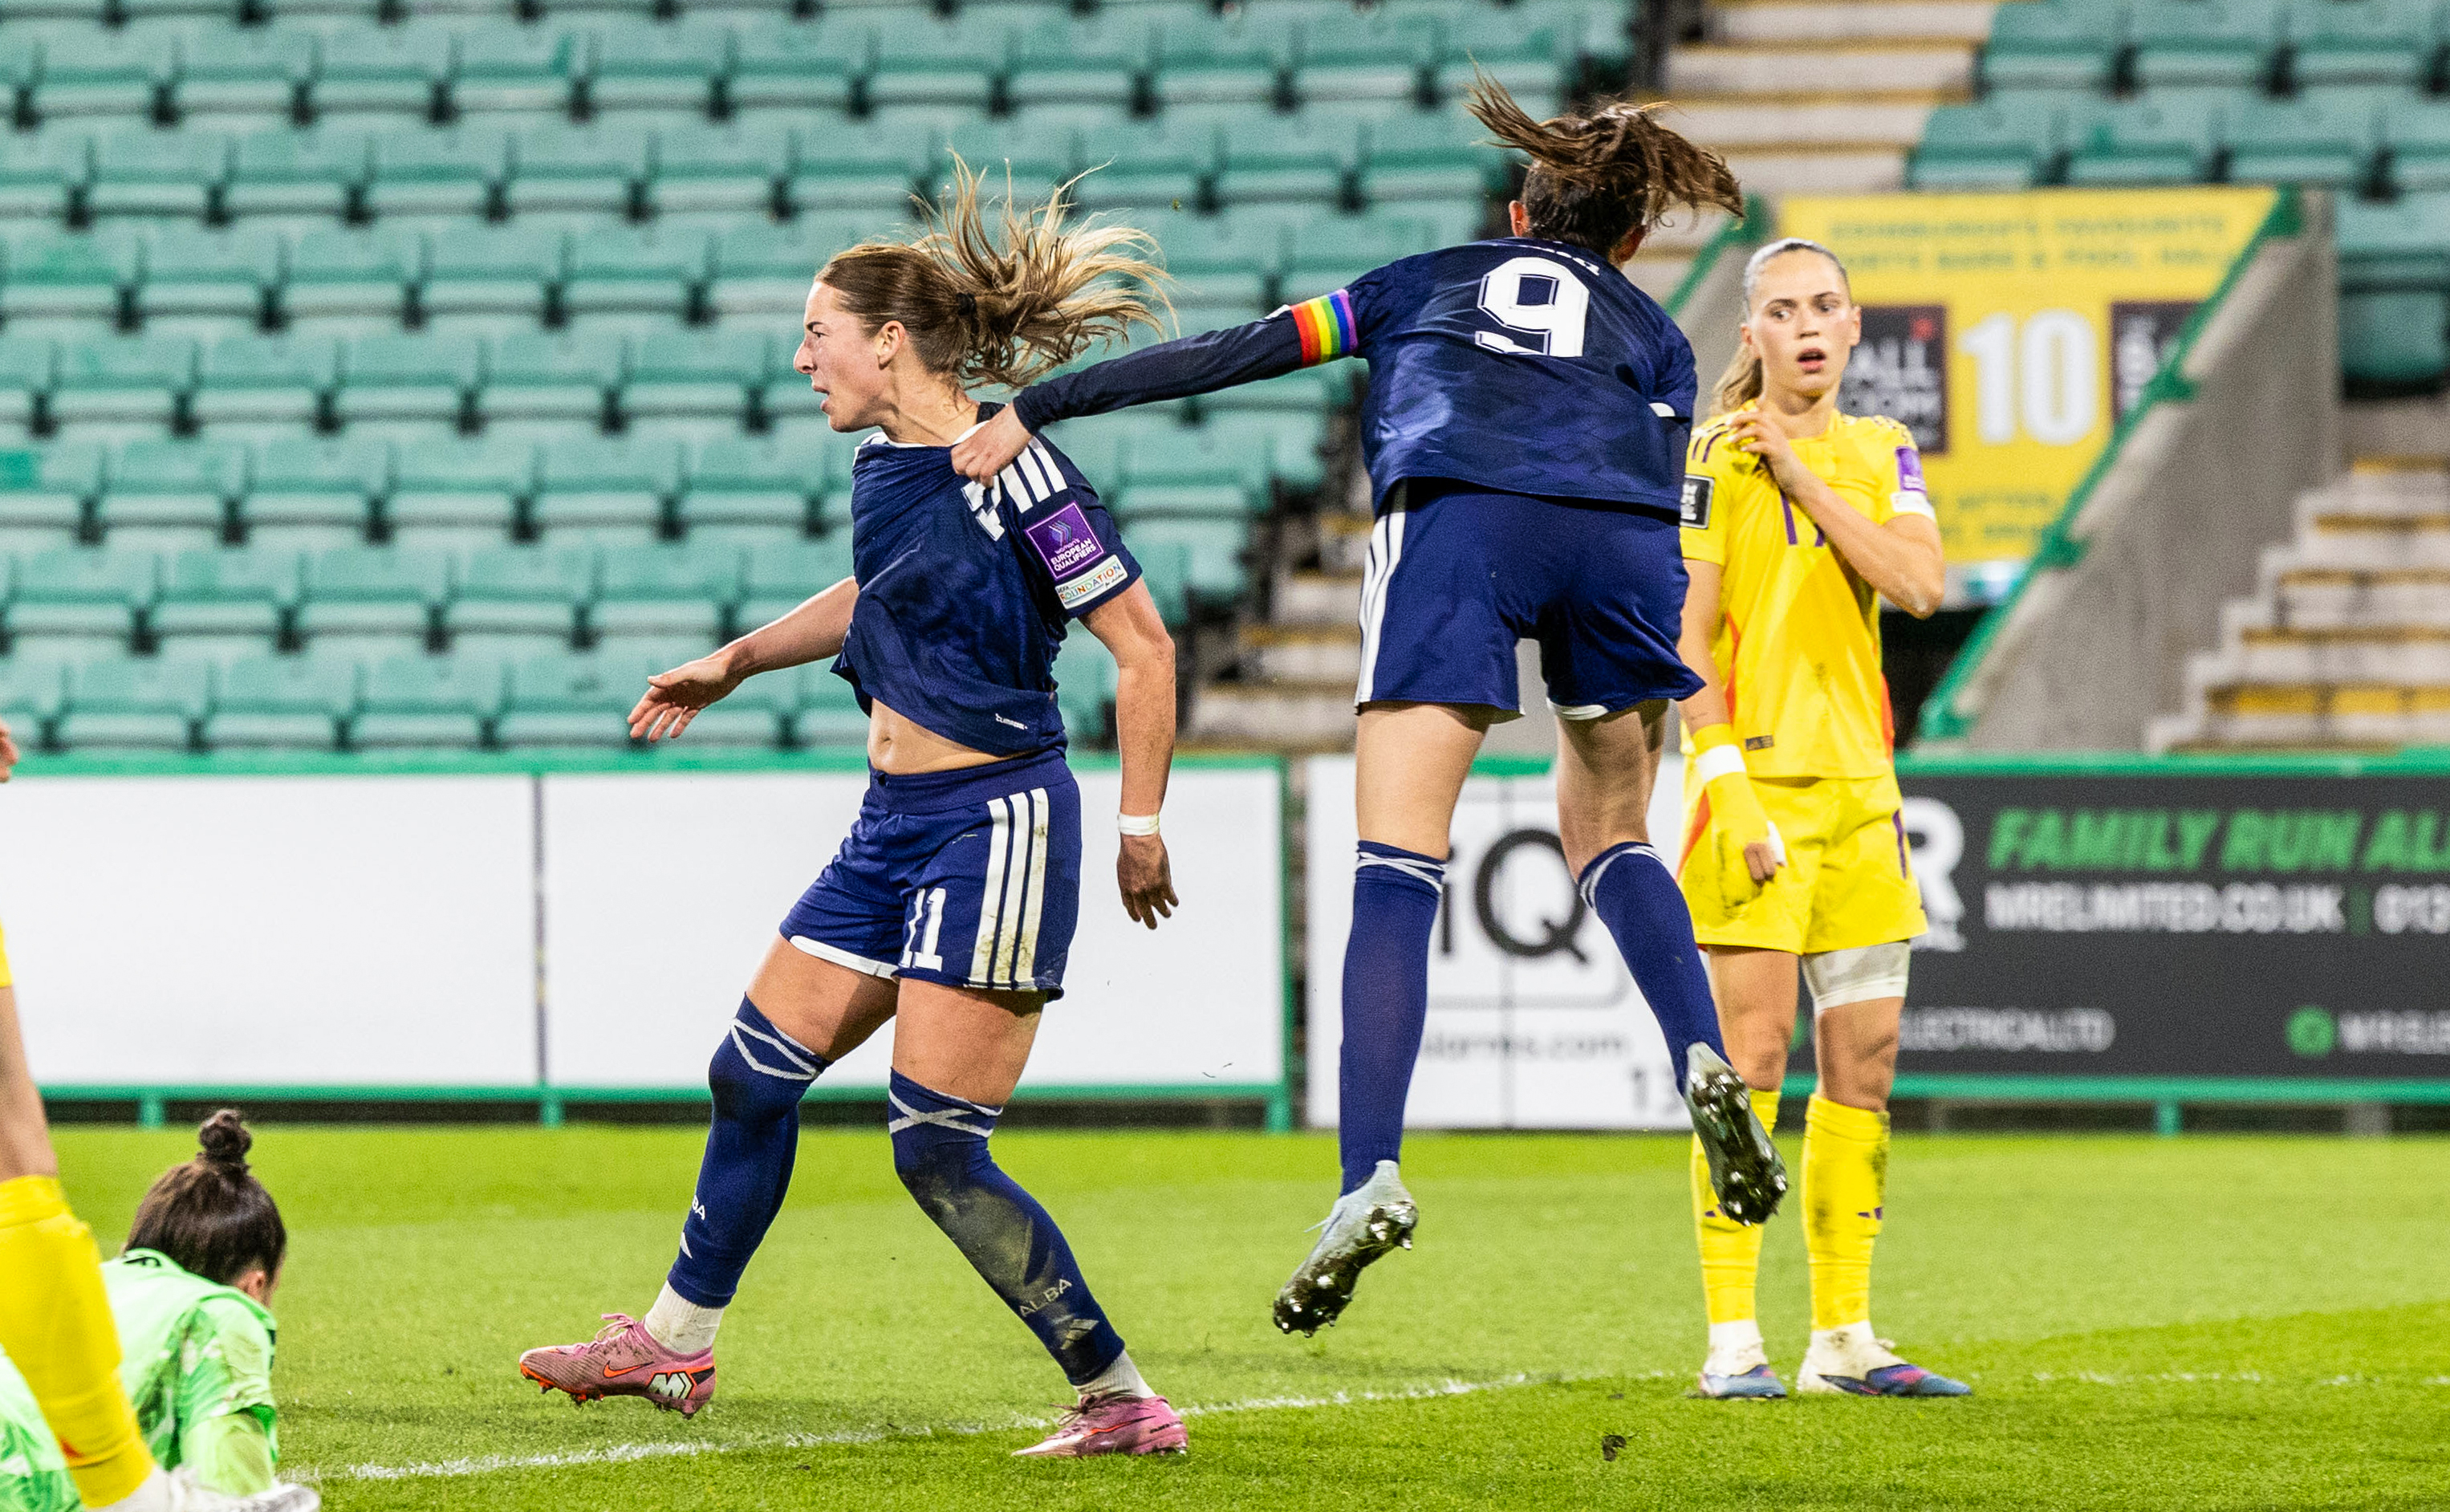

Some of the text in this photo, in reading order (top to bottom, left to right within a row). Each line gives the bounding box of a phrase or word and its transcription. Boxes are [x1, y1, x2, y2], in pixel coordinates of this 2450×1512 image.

[1476, 257, 1590, 358] 9
[1960, 307, 2099, 446] 10
[1050, 537, 1093, 566] EUROPEAN
[1053, 543, 1097, 571] QUALIFIERS
[1058, 563, 1122, 601] FOUNDATION
[1987, 808, 2220, 872] FAMILY
[2220, 808, 2363, 872] RUN
[899, 887, 947, 973] 11
[1019, 1278, 1073, 1317] ALBA
